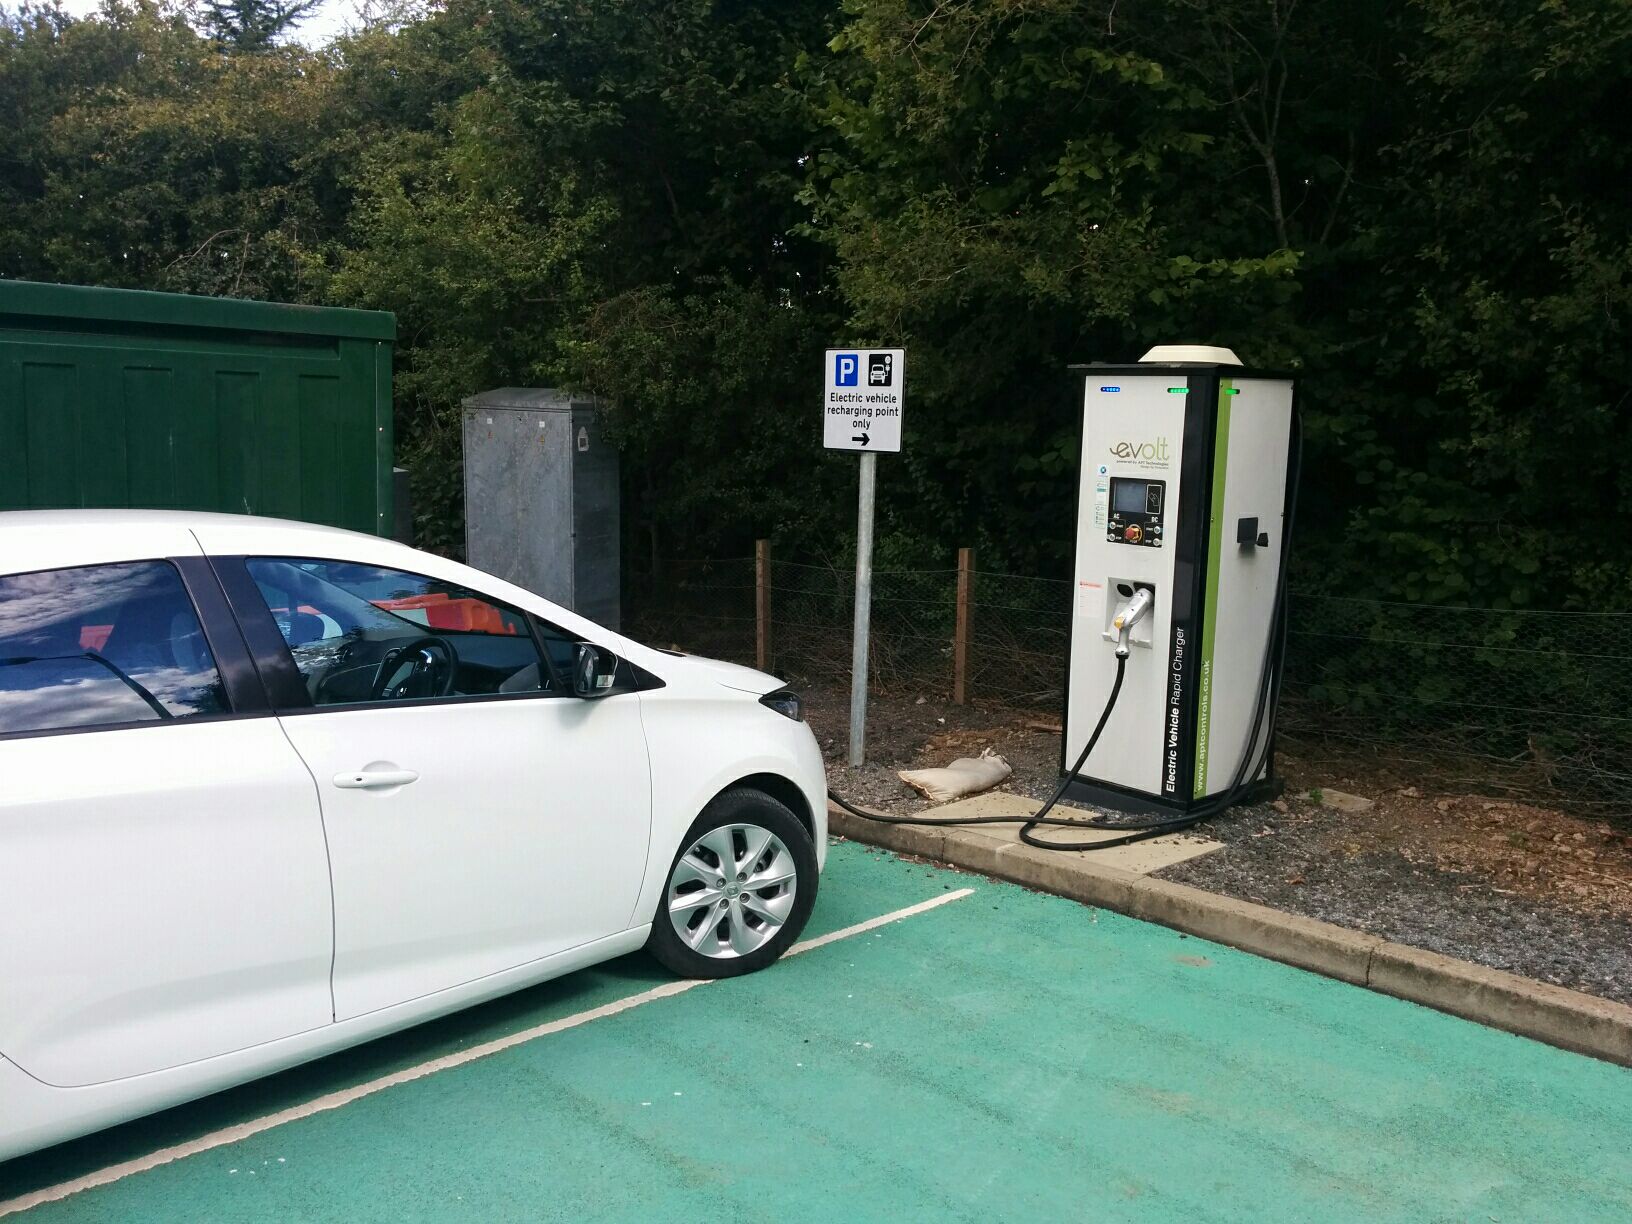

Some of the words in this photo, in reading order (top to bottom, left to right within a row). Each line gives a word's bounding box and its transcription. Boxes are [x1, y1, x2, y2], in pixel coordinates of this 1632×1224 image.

[840, 358, 854, 384] P
[827, 404, 873, 418] recharging
[875, 406, 899, 418] point
[830, 392, 863, 403] Electric
[865, 392, 897, 404] vehicle
[852, 418, 871, 431] only
[1109, 436, 1170, 461] evolt
[1172, 626, 1186, 671] Charger
[1171, 673, 1183, 706] Rapid
[1168, 707, 1180, 748] Vehicle
[1197, 659, 1210, 791] www.aptcontrols.co.uk
[1166, 749, 1177, 793] Electric
